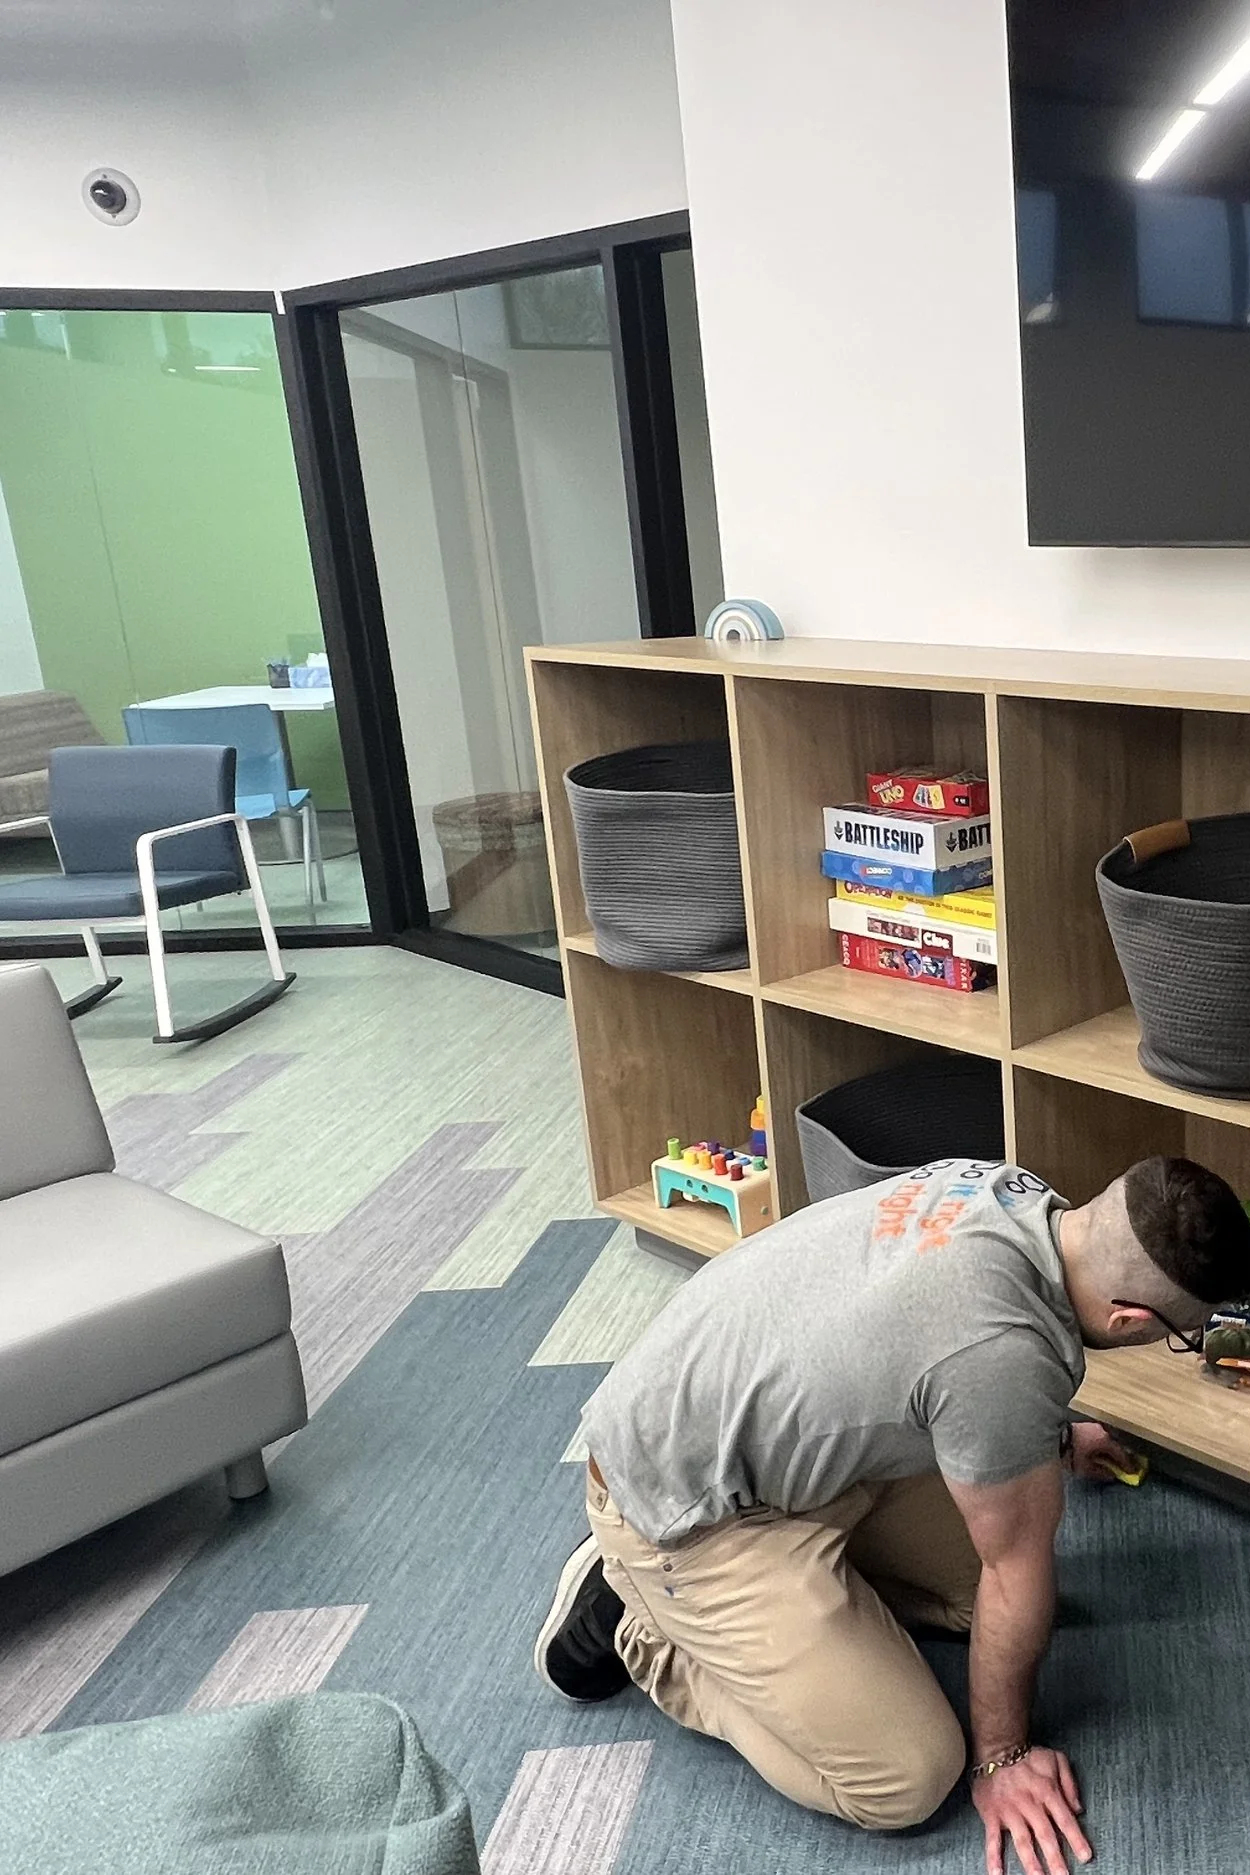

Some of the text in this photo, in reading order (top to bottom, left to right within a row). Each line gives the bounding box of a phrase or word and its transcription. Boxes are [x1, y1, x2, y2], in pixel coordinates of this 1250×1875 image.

[879, 785, 905, 804] UNO
[844, 821, 924, 855] BATTLESHIP
[959, 958, 968, 989] IXAR
[873, 1183, 927, 1241] right
